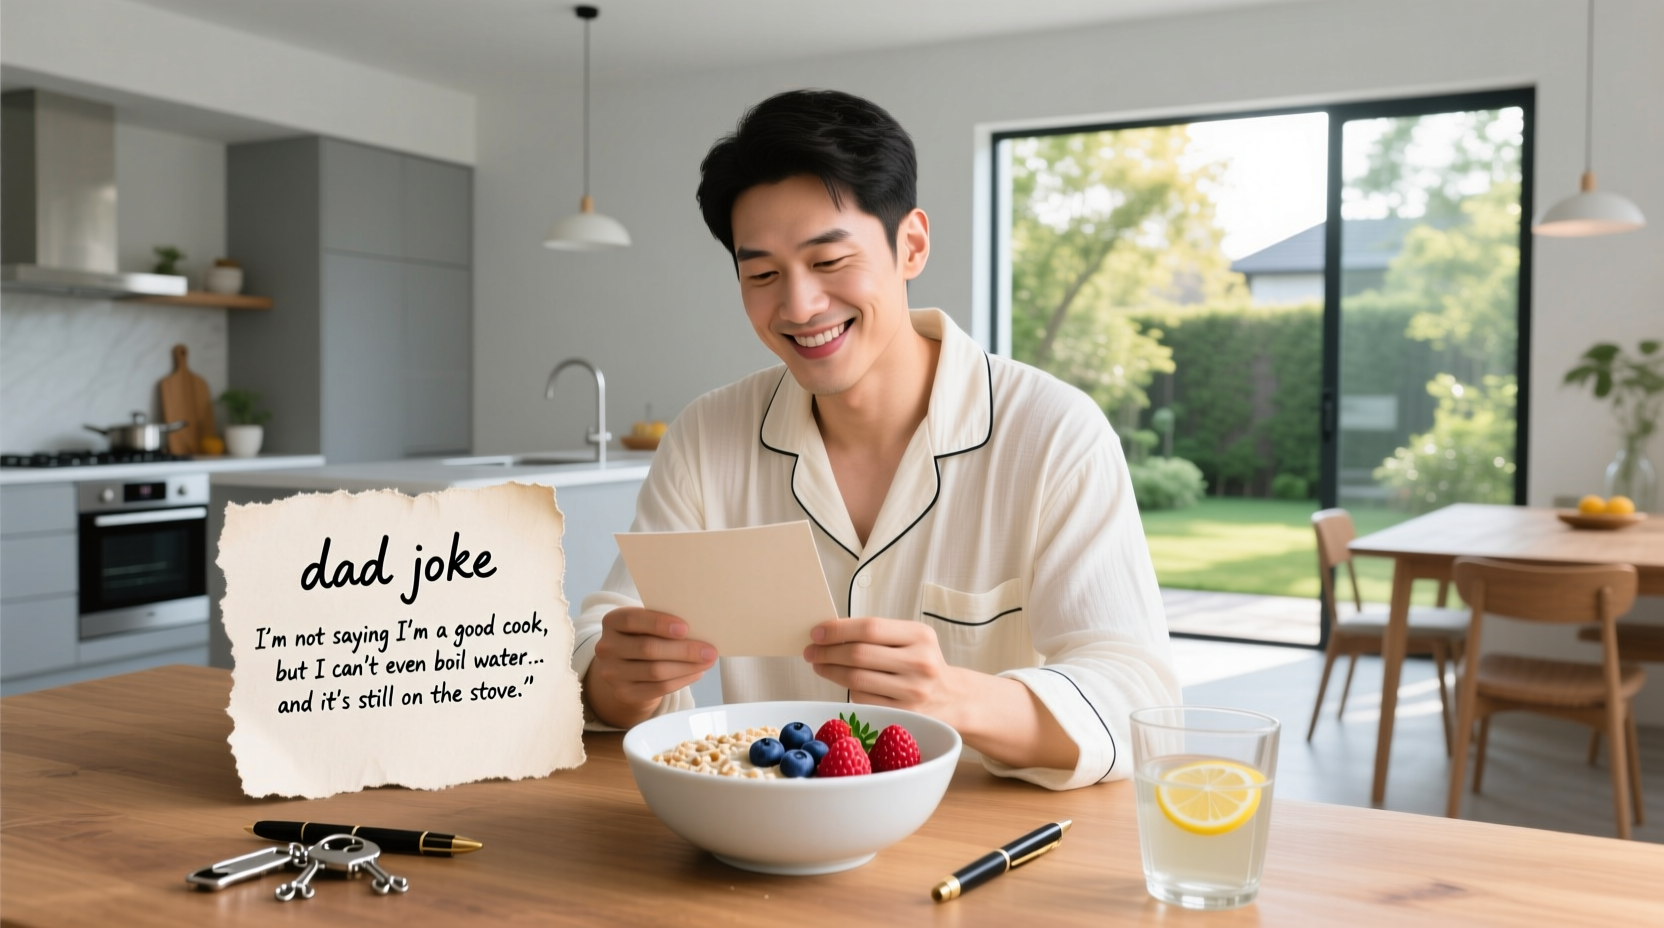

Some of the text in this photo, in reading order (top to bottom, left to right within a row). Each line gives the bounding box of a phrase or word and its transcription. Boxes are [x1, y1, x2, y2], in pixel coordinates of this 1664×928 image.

[300, 531, 498, 605] dad joke
[254, 611, 548, 654] I'm not saying I'm a good cook,
[275, 647, 544, 682] but I can't even boil water...
[277, 689, 314, 714] and
[321, 688, 350, 711] it's
[358, 684, 394, 709] still
[401, 692, 423, 706] on
[430, 680, 463, 704] the
